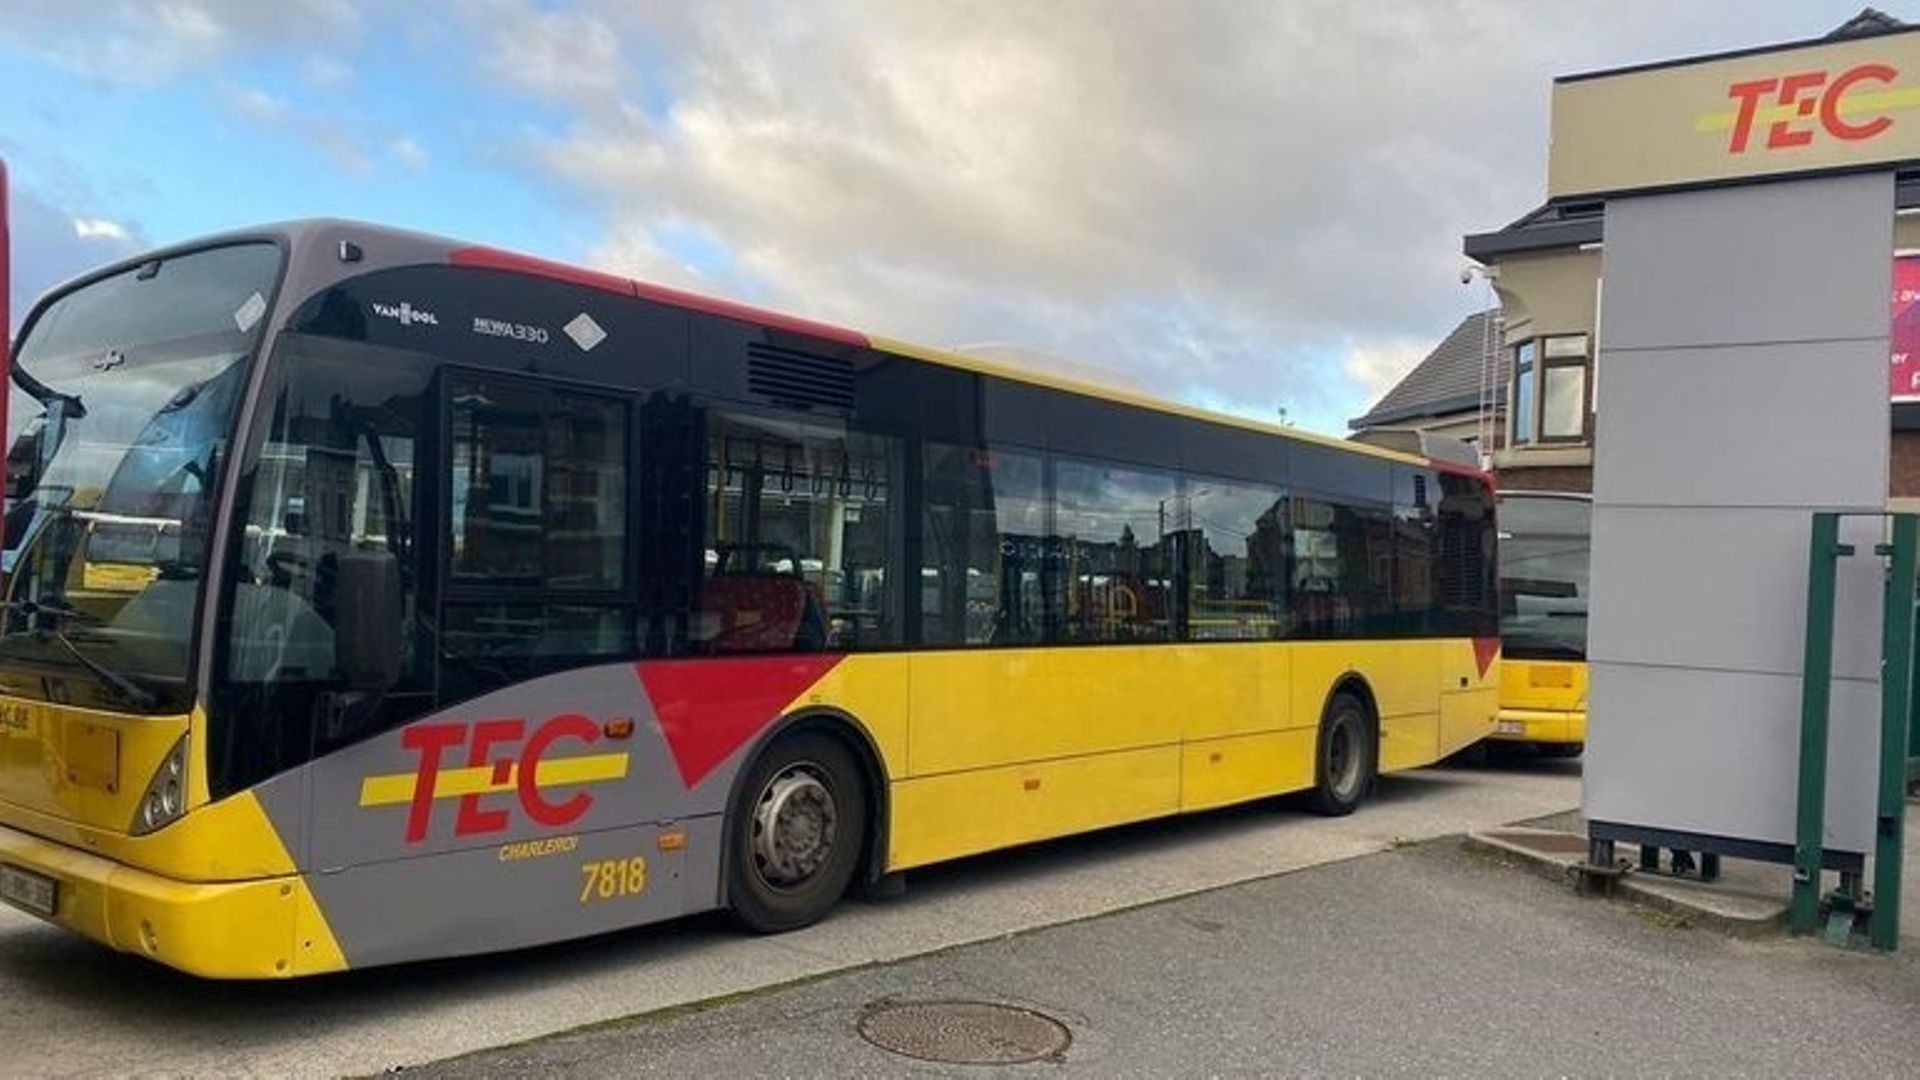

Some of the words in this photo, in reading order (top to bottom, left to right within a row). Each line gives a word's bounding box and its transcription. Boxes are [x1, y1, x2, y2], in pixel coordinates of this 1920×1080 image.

[1728, 64, 1898, 154] TEC
[402, 714, 602, 844] TEC
[499, 836, 580, 862] CHARLEROI
[580, 856, 646, 902] 7818
